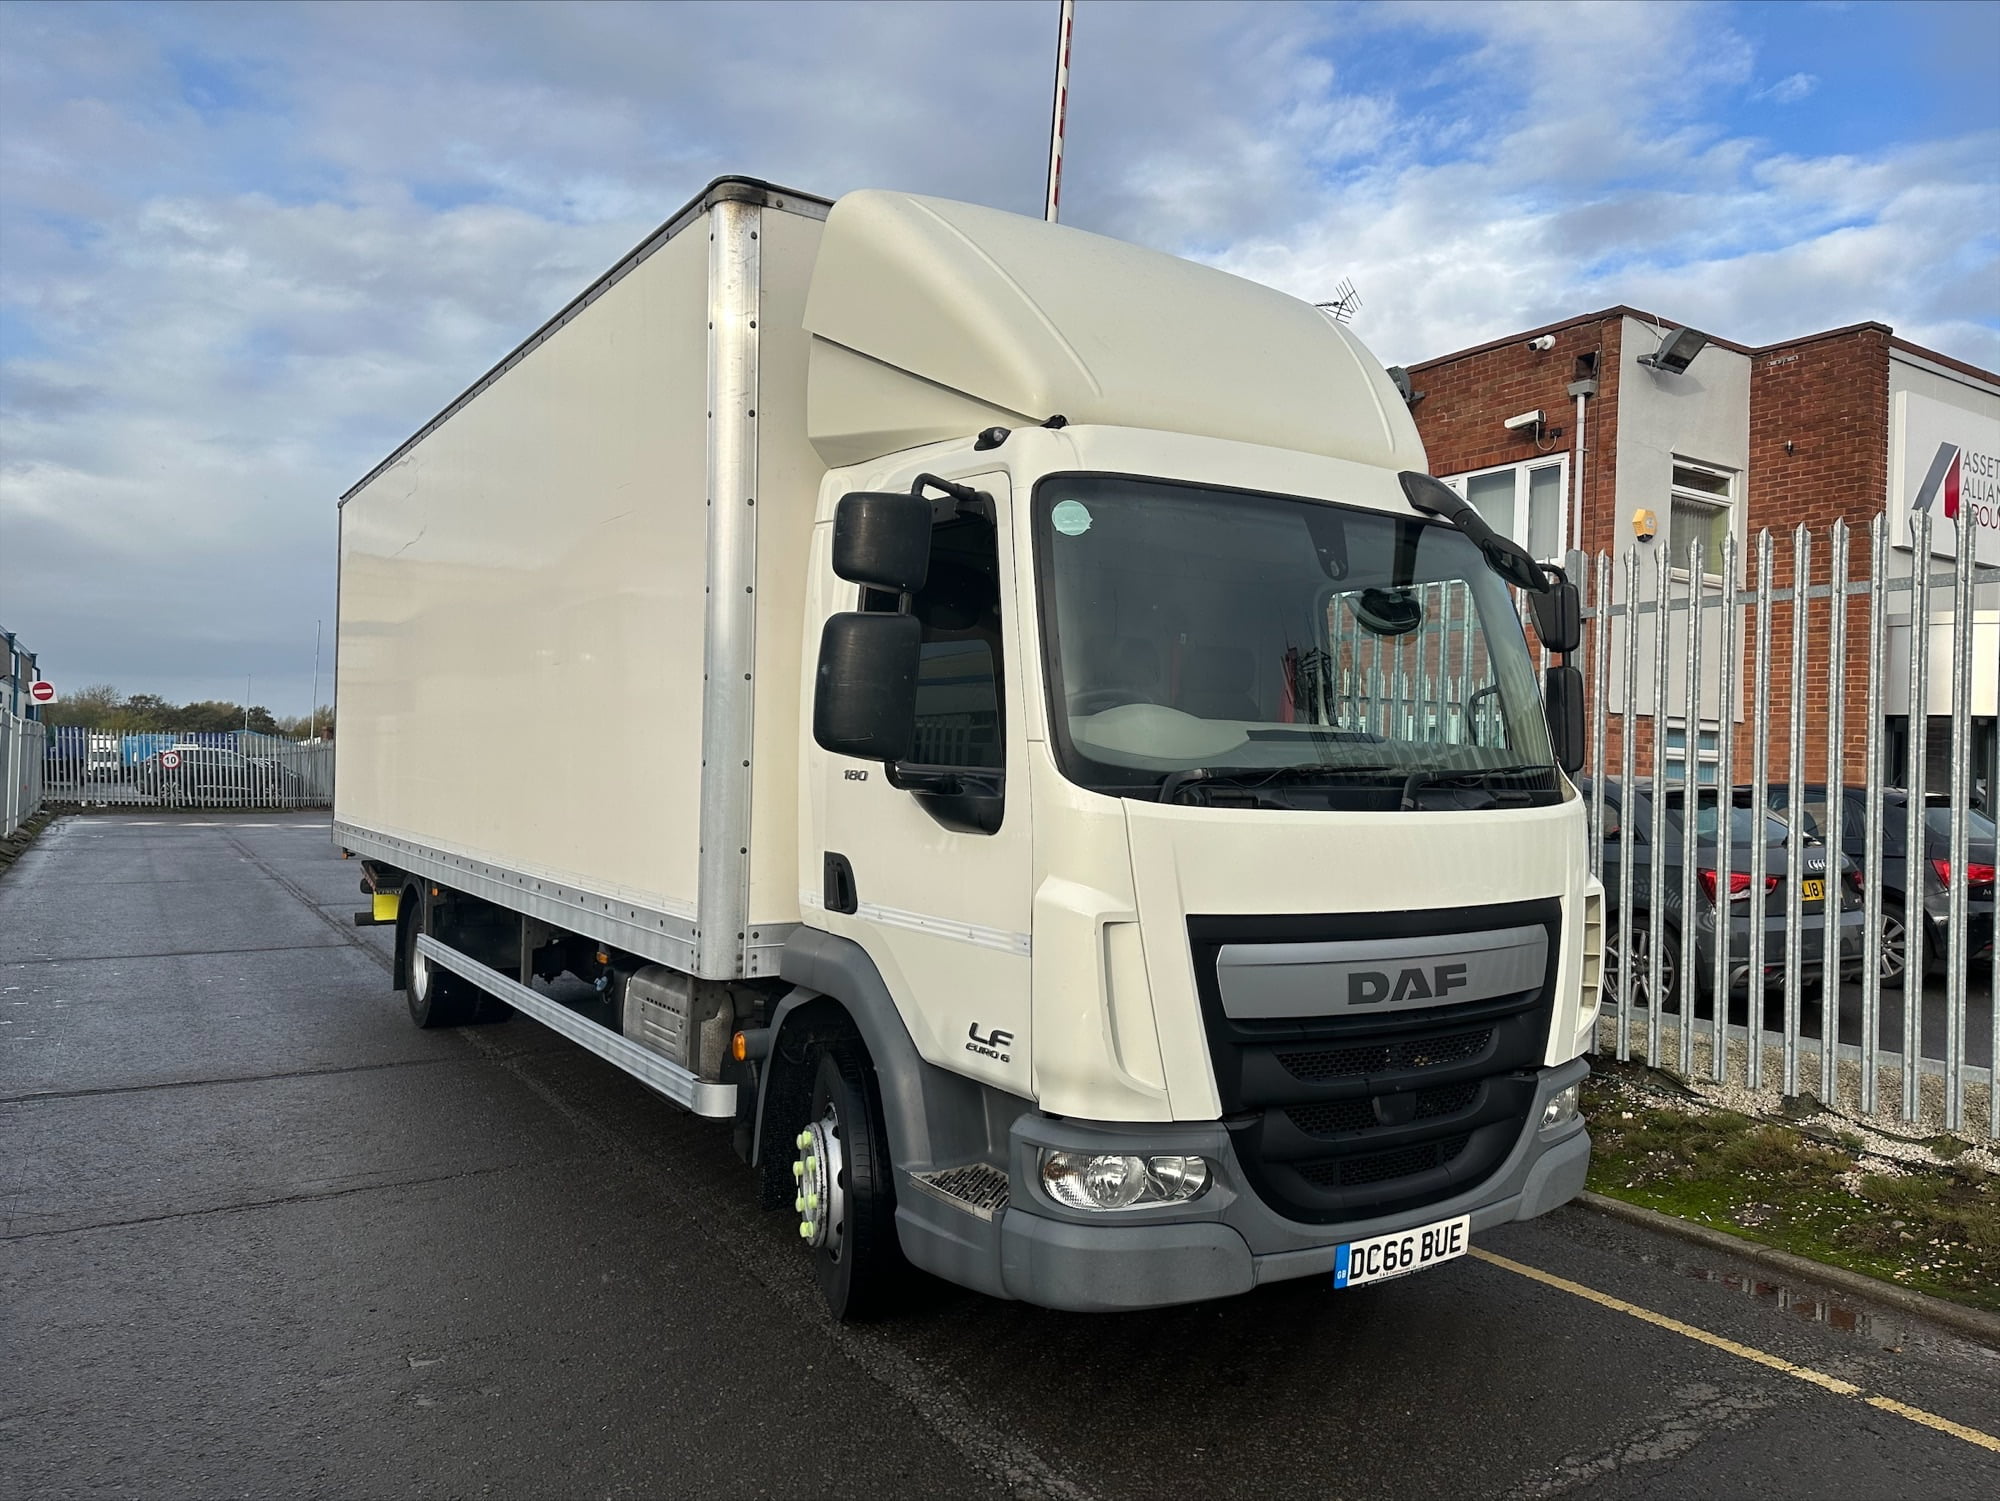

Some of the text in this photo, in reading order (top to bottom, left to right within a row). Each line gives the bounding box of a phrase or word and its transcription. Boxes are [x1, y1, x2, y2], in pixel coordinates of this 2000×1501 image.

[1962, 451, 2000, 479] ASSET
[1971, 503, 2000, 530] ROU
[165, 756, 176, 765] 10
[844, 770, 868, 781] 180
[1801, 882, 1819, 897] L18
[1348, 963, 1466, 1005] DAF
[969, 1022, 1014, 1047] LF
[966, 1043, 1010, 1063] EURO 6
[1350, 1236, 1414, 1280] DC66
[1420, 1223, 1463, 1262] BUE
[1337, 1270, 1347, 1279] GB
